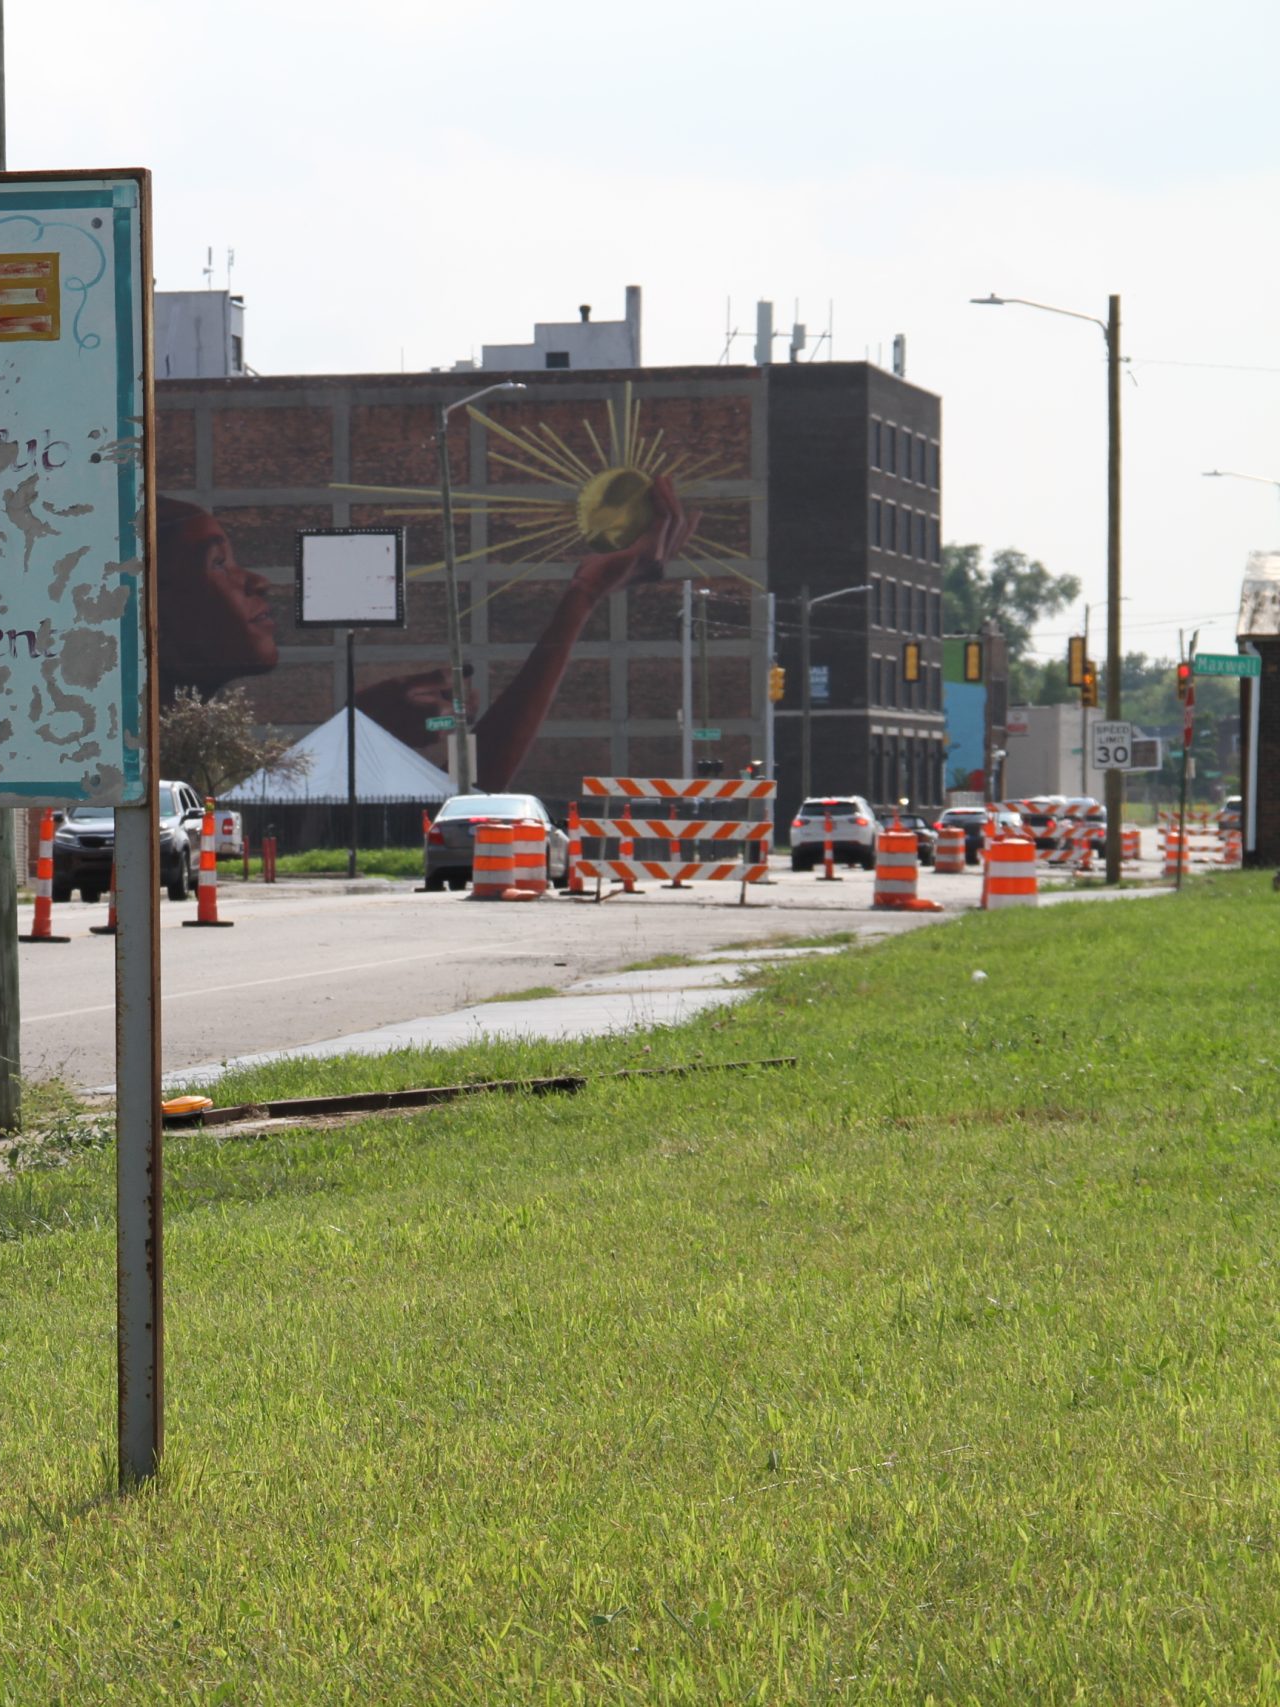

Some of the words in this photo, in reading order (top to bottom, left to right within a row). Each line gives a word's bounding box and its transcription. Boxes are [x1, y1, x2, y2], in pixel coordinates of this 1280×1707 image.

[1197, 656, 1257, 675] Maxwell
[1096, 725, 1130, 735] SPEED
[1099, 736, 1126, 745] LIMIT
[1097, 745, 1129, 764] 30
